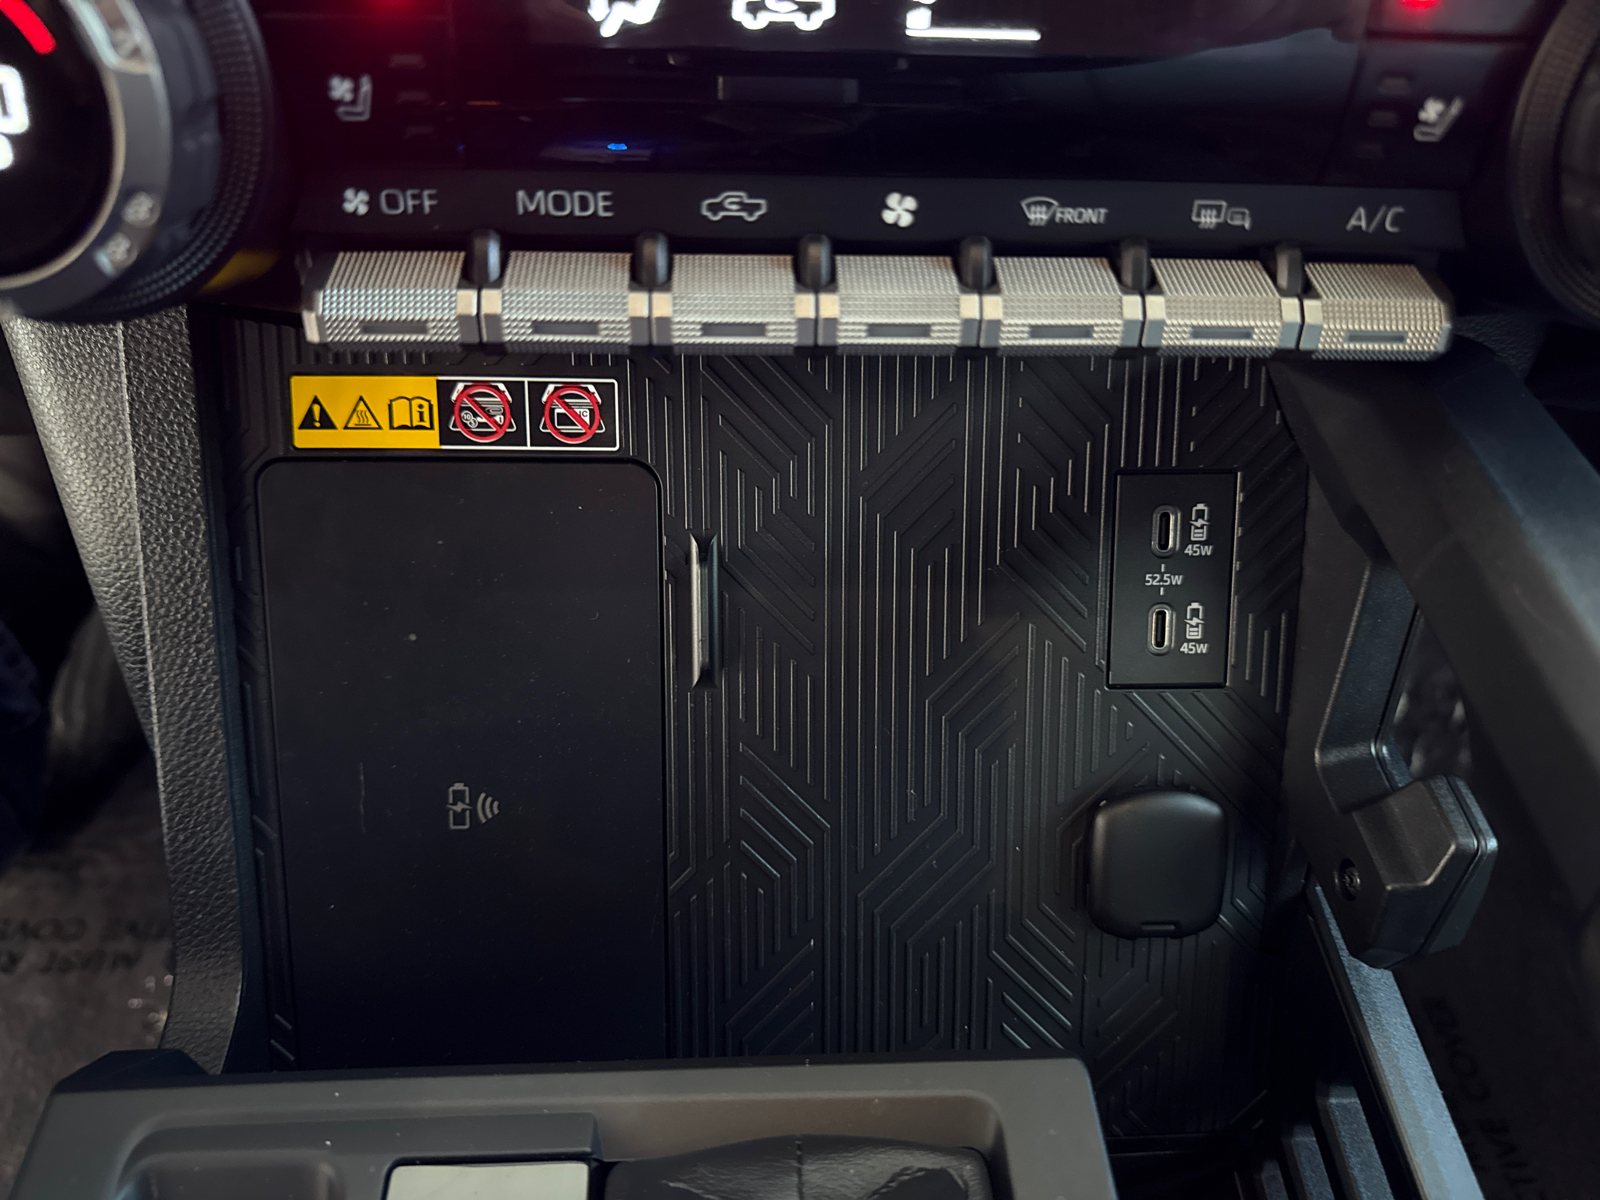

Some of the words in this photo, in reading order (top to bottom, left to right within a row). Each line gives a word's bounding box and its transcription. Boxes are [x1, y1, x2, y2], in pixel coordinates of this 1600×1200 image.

[379, 188, 438, 216] OFF
[515, 189, 615, 217] MODE
[1054, 206, 1108, 225] FRONT
[1346, 205, 1405, 234] A/C
[1184, 544, 1213, 557] 45W
[1145, 573, 1184, 586] 52.5W
[1180, 642, 1209, 655] 45W
